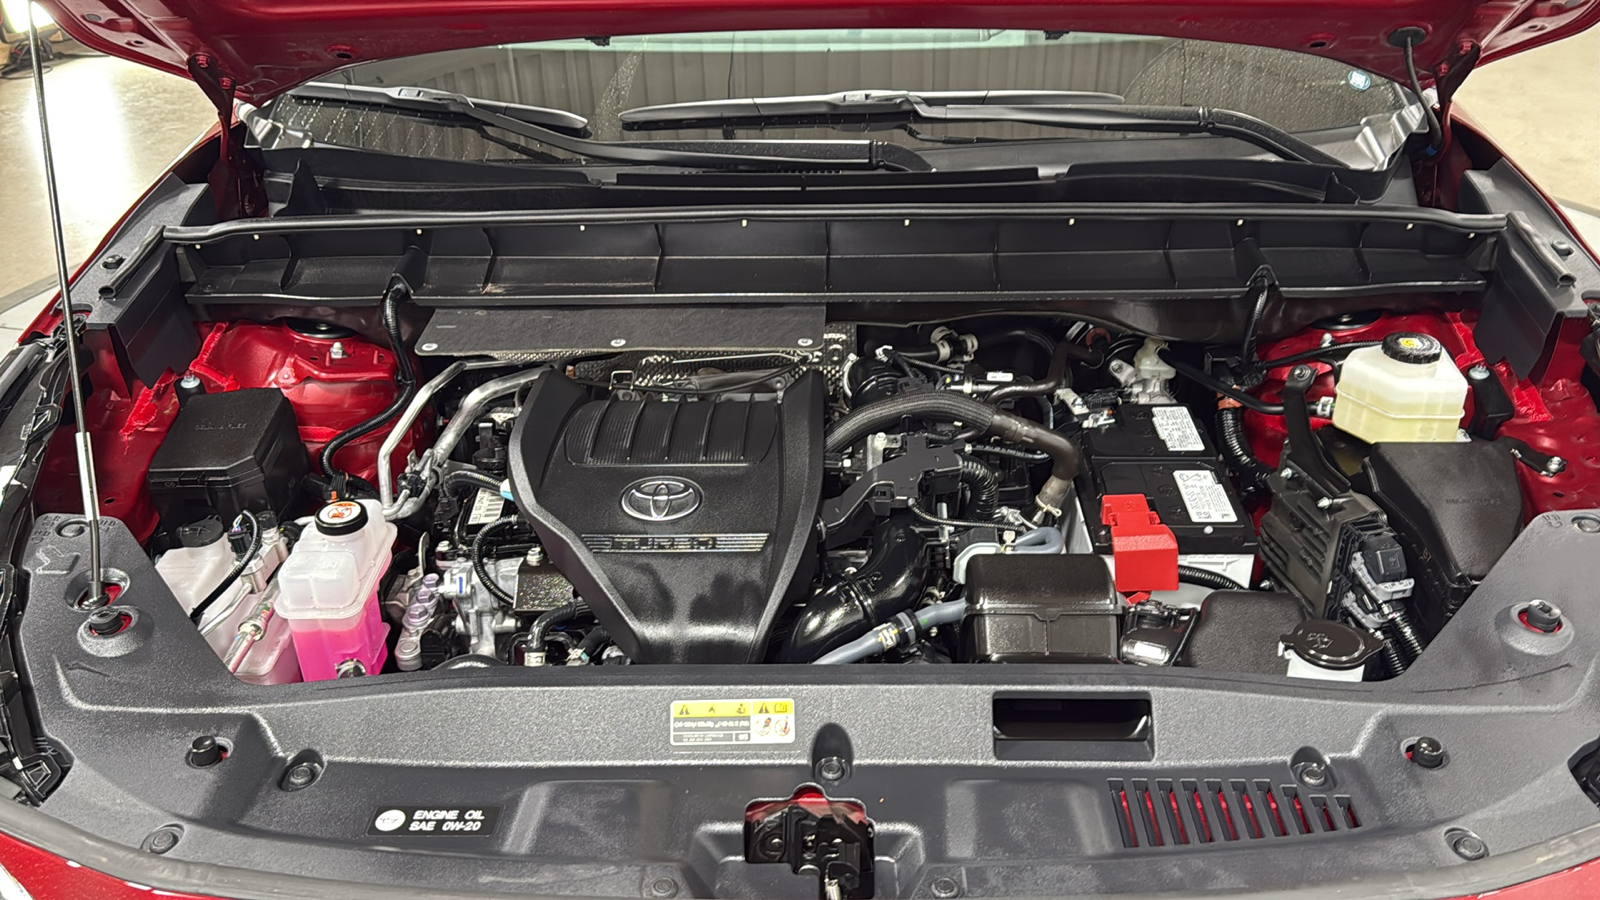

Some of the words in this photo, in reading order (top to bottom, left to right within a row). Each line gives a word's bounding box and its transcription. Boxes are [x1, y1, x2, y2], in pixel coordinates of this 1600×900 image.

[614, 537, 713, 550] TURBO
[412, 810, 459, 820] ENGINE
[463, 810, 485, 820] OIL
[408, 821, 437, 831] SAE
[441, 821, 481, 831] 0W-20
